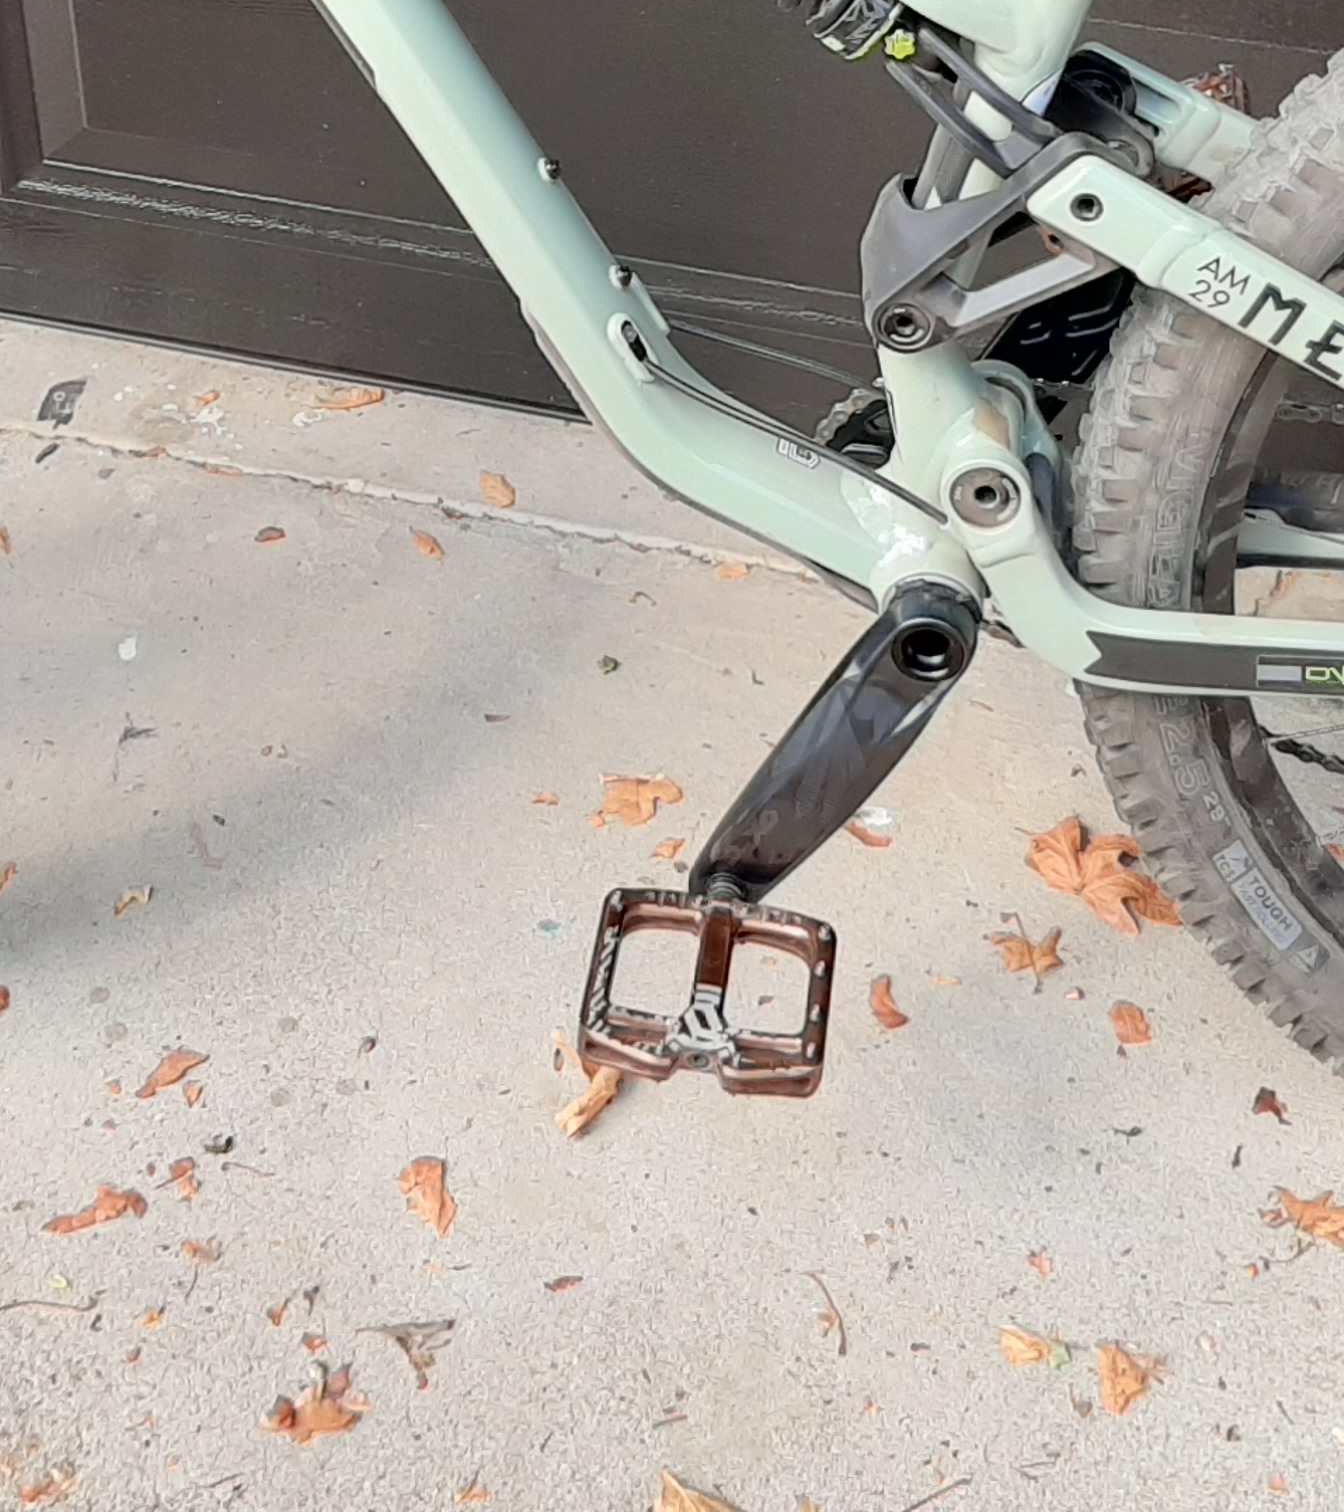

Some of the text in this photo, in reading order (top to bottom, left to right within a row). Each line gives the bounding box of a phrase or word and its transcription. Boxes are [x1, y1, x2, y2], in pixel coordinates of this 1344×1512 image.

[1189, 278, 1232, 309] 29
[1197, 256, 1252, 296] AM
[1246, 876, 1295, 934] TOUGH
